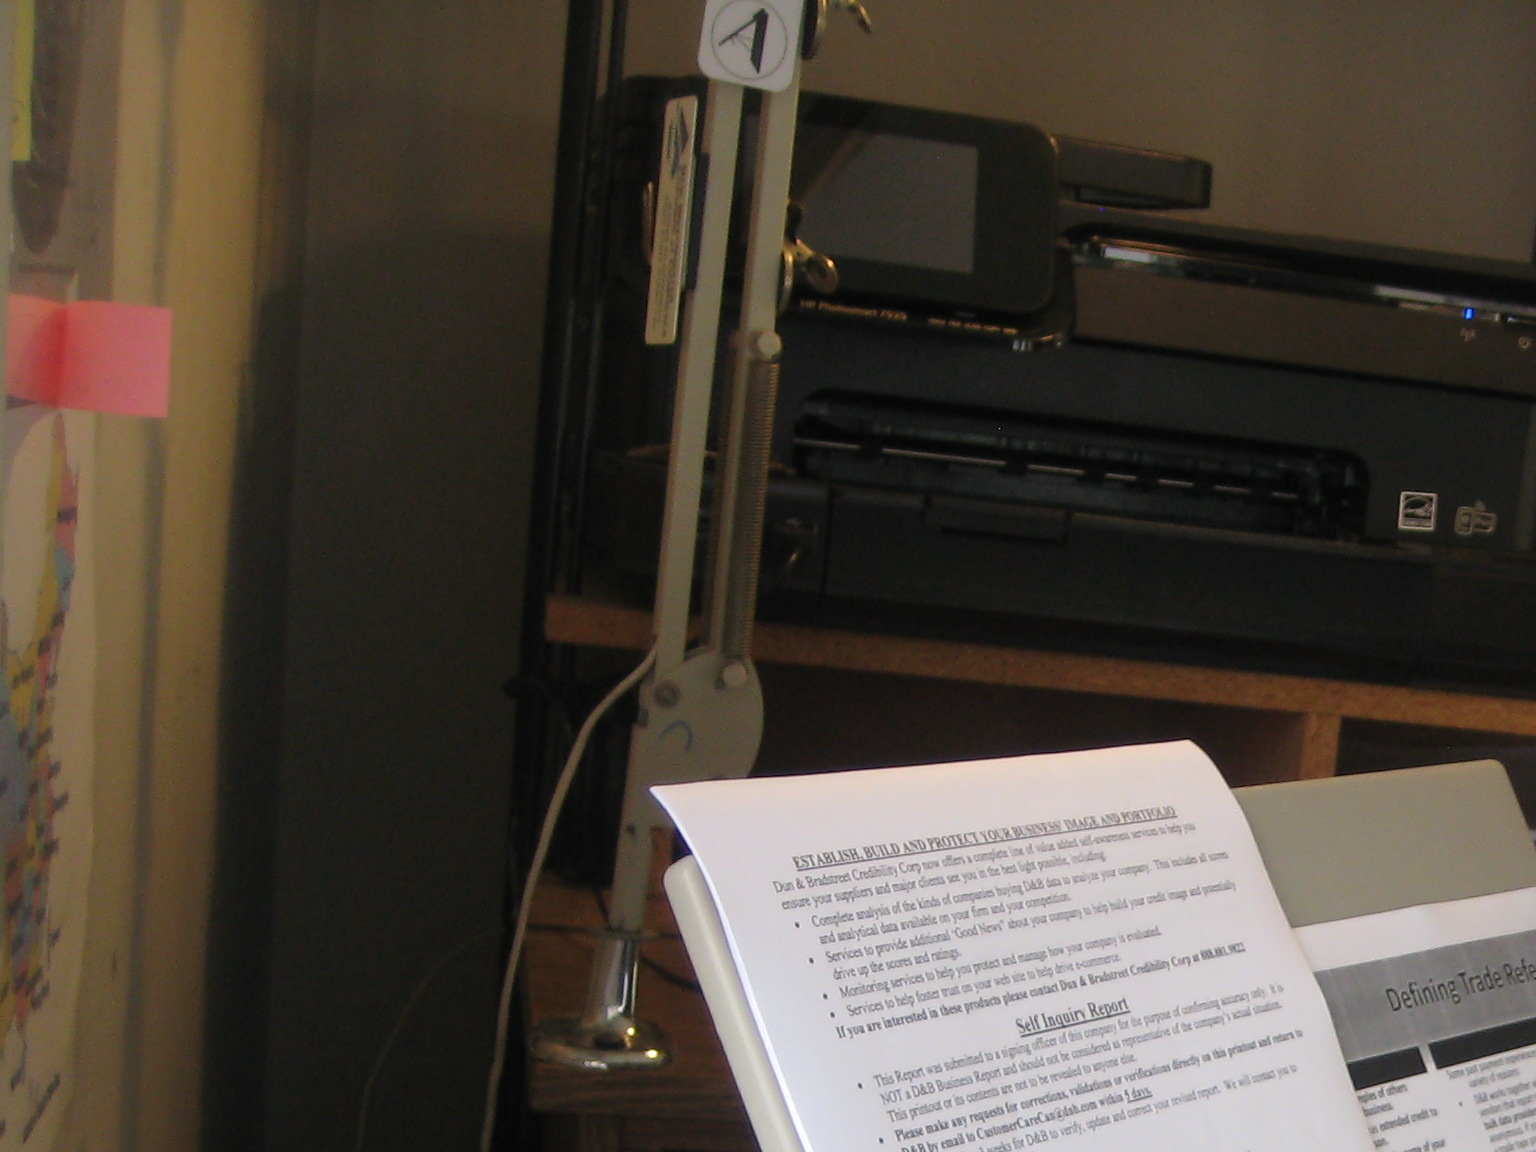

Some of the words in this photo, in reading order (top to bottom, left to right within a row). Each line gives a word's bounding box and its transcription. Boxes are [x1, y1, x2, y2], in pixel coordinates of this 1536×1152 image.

[772, 880, 794, 893] Dun
[805, 872, 851, 887] Bradstreet
[851, 865, 897, 880] Credibility
[921, 860, 940, 870] now
[941, 854, 965, 867] offers
[973, 849, 1008, 862] complete
[1035, 841, 1056, 852] value
[1056, 838, 1079, 849] added
[1130, 828, 1158, 838] services
[863, 843, 903, 861] BUILD
[902, 839, 929, 856] AND
[927, 832, 979, 852] PROTECT
[979, 827, 1013, 844] YOUR
[1063, 815, 1099, 832] IMAGE
[1100, 813, 1122, 827] AND
[1120, 806, 1175, 824] PORTFOLIO
[835, 1025, 846, 1038] If
[866, 1021, 881, 1032] are
[882, 1009, 927, 1028] interested
[927, 1008, 939, 1018] in
[939, 1004, 962, 1016] these
[963, 996, 1001, 1013] products
[1002, 991, 1028, 1005] please
[1029, 983, 1059, 997] contact
[1058, 979, 1078, 991] Dun
[1087, 968, 1129, 984] Bradstreet
[1129, 959, 1170, 975] Credibility
[1385, 978, 1461, 1012] Defining
[1457, 964, 1502, 996] Trade
[1015, 1014, 1044, 1037] Self
[1041, 1009, 1088, 1031] Inquiry
[1087, 998, 1130, 1021] Report
[940, 1132, 965, 1149] email
[1098, 1093, 1124, 1106] within
